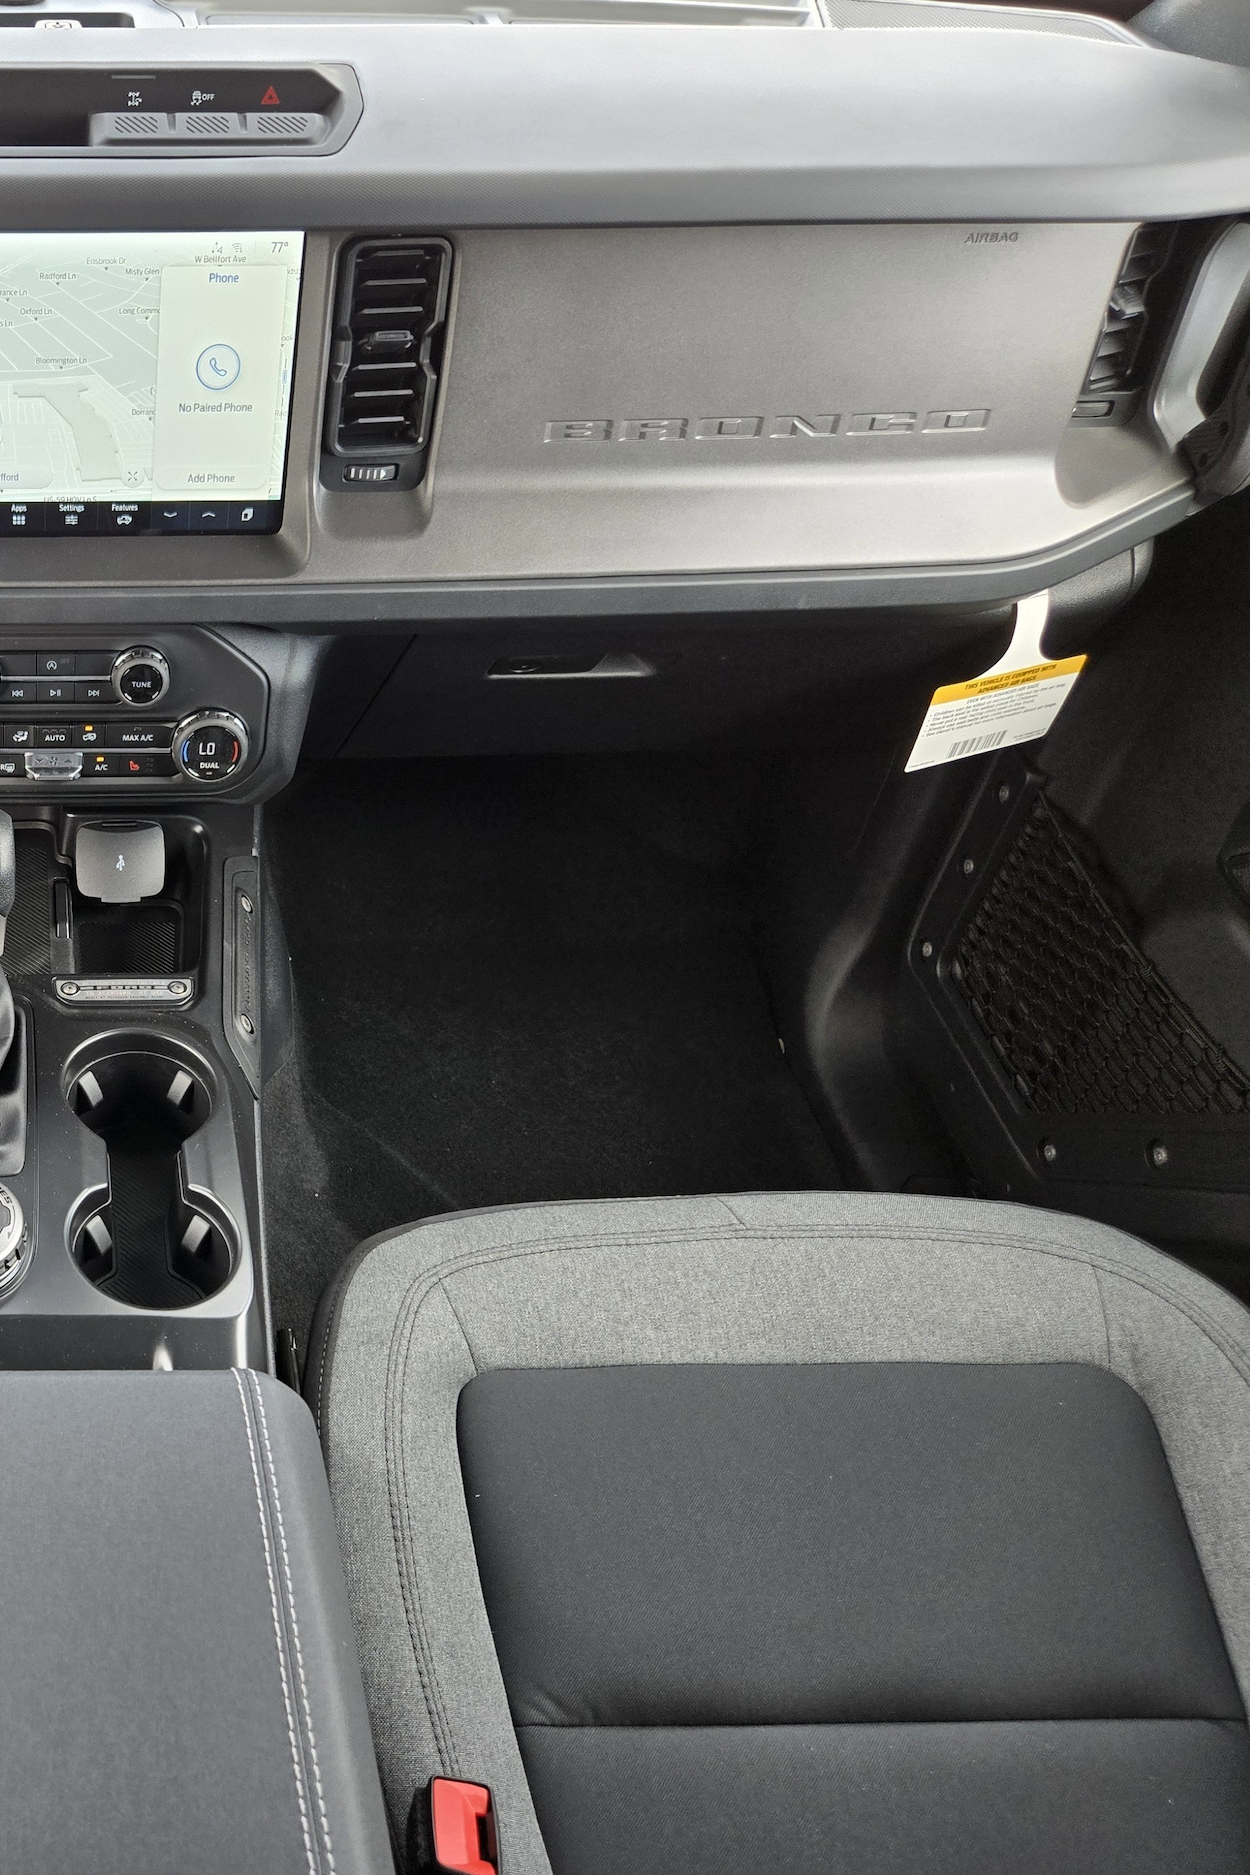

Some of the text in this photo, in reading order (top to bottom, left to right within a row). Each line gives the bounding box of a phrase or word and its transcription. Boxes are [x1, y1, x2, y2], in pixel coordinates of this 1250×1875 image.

[963, 231, 1019, 244] AIRBAG
[271, 242, 289, 253] 77°
[195, 255, 202, 263] W
[232, 255, 246, 263] Ave
[39, 272, 76, 280] Radford Ln
[125, 267, 160, 276] Misty Glen
[209, 273, 239, 283] Phone
[20, 307, 43, 315] Oxford
[119, 307, 136, 316] Long
[35, 356, 88, 366] Bloomington Ln
[179, 403, 253, 413] No Paired Phone
[543, 408, 992, 443] BRONCO
[188, 474, 236, 483] Add Phone
[11, 504, 27, 513] Apps
[59, 504, 85, 513] Settings
[111, 503, 138, 512] Features
[964, 682, 978, 690] THIS
[978, 676, 1004, 686] VEHICLE
[1011, 667, 1040, 679] EQUIPPED
[1040, 664, 1056, 672] WITH
[977, 681, 1009, 693] ADVANCED
[1020, 675, 1036, 683] BAGS
[45, 734, 66, 742] AUTO
[122, 734, 154, 742] MAX A/C
[199, 742, 216, 756] LO
